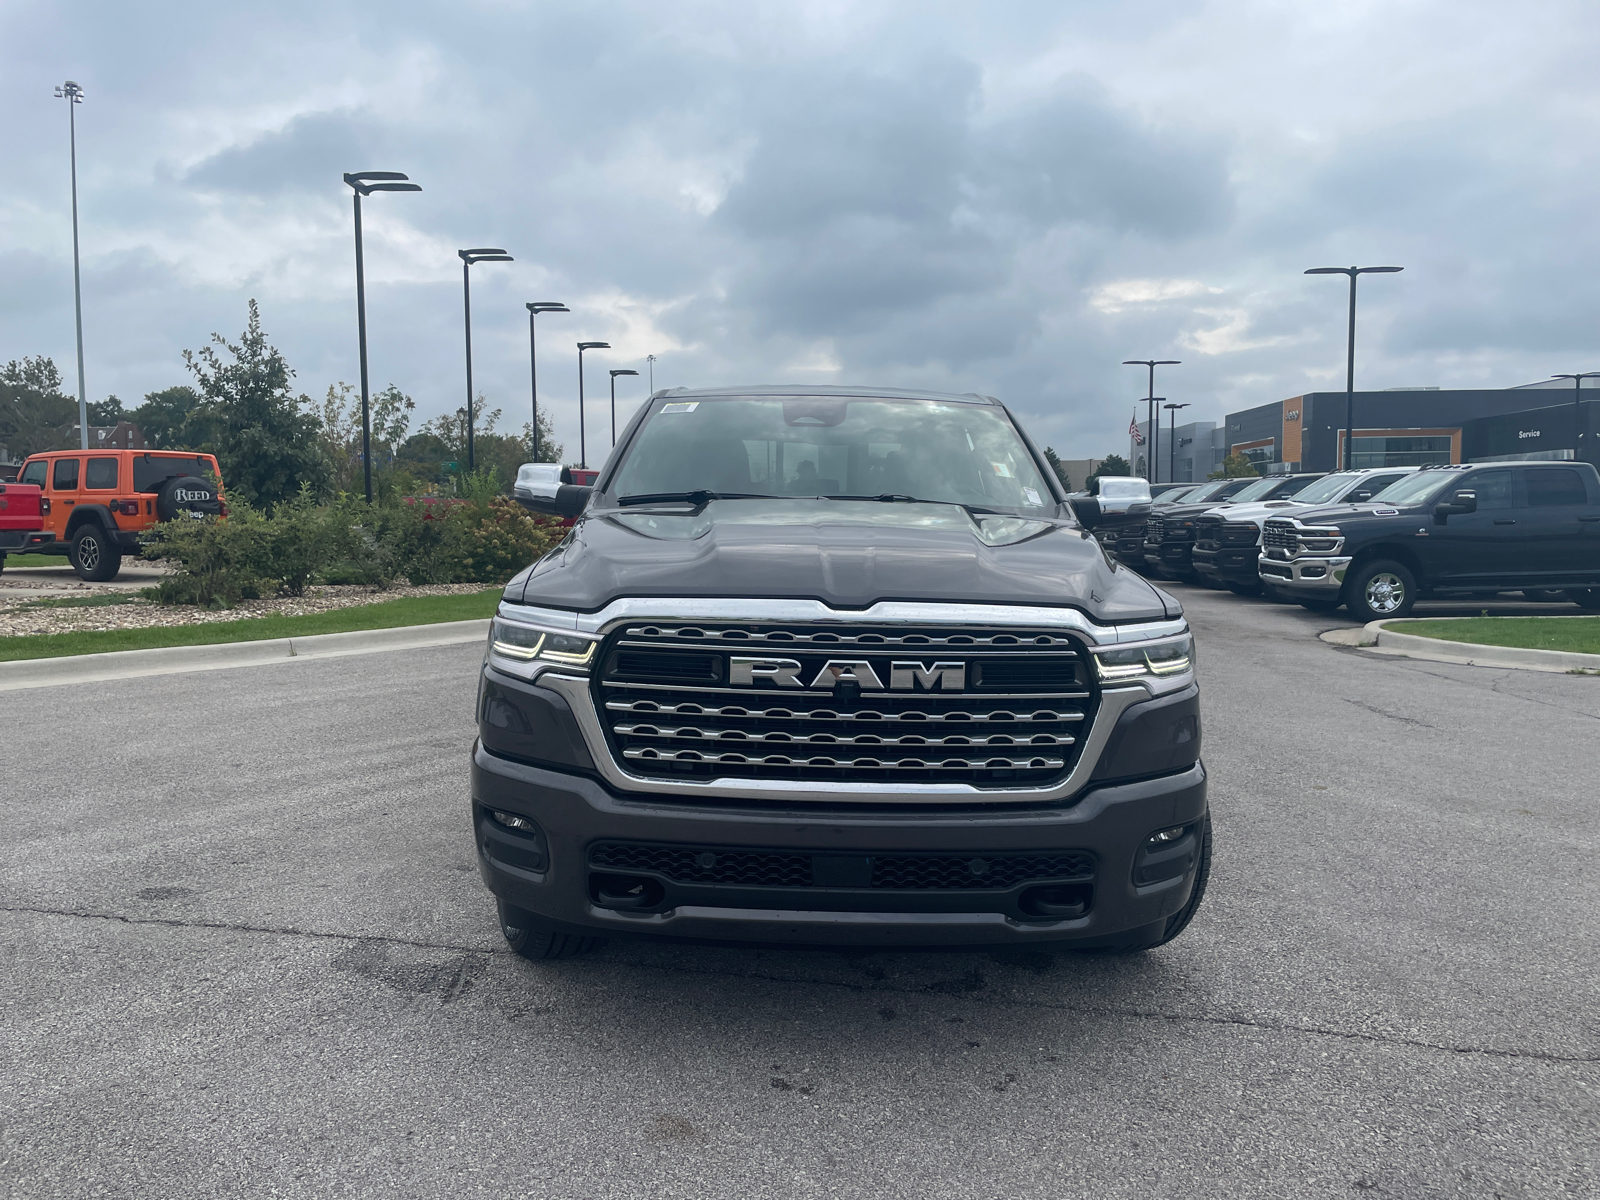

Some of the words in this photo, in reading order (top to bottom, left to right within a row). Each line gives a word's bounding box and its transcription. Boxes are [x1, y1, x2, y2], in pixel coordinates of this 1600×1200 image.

[1518, 430, 1540, 438] Service
[175, 488, 210, 502] REED
[189, 511, 204, 519] eep
[729, 656, 966, 690] RAM
